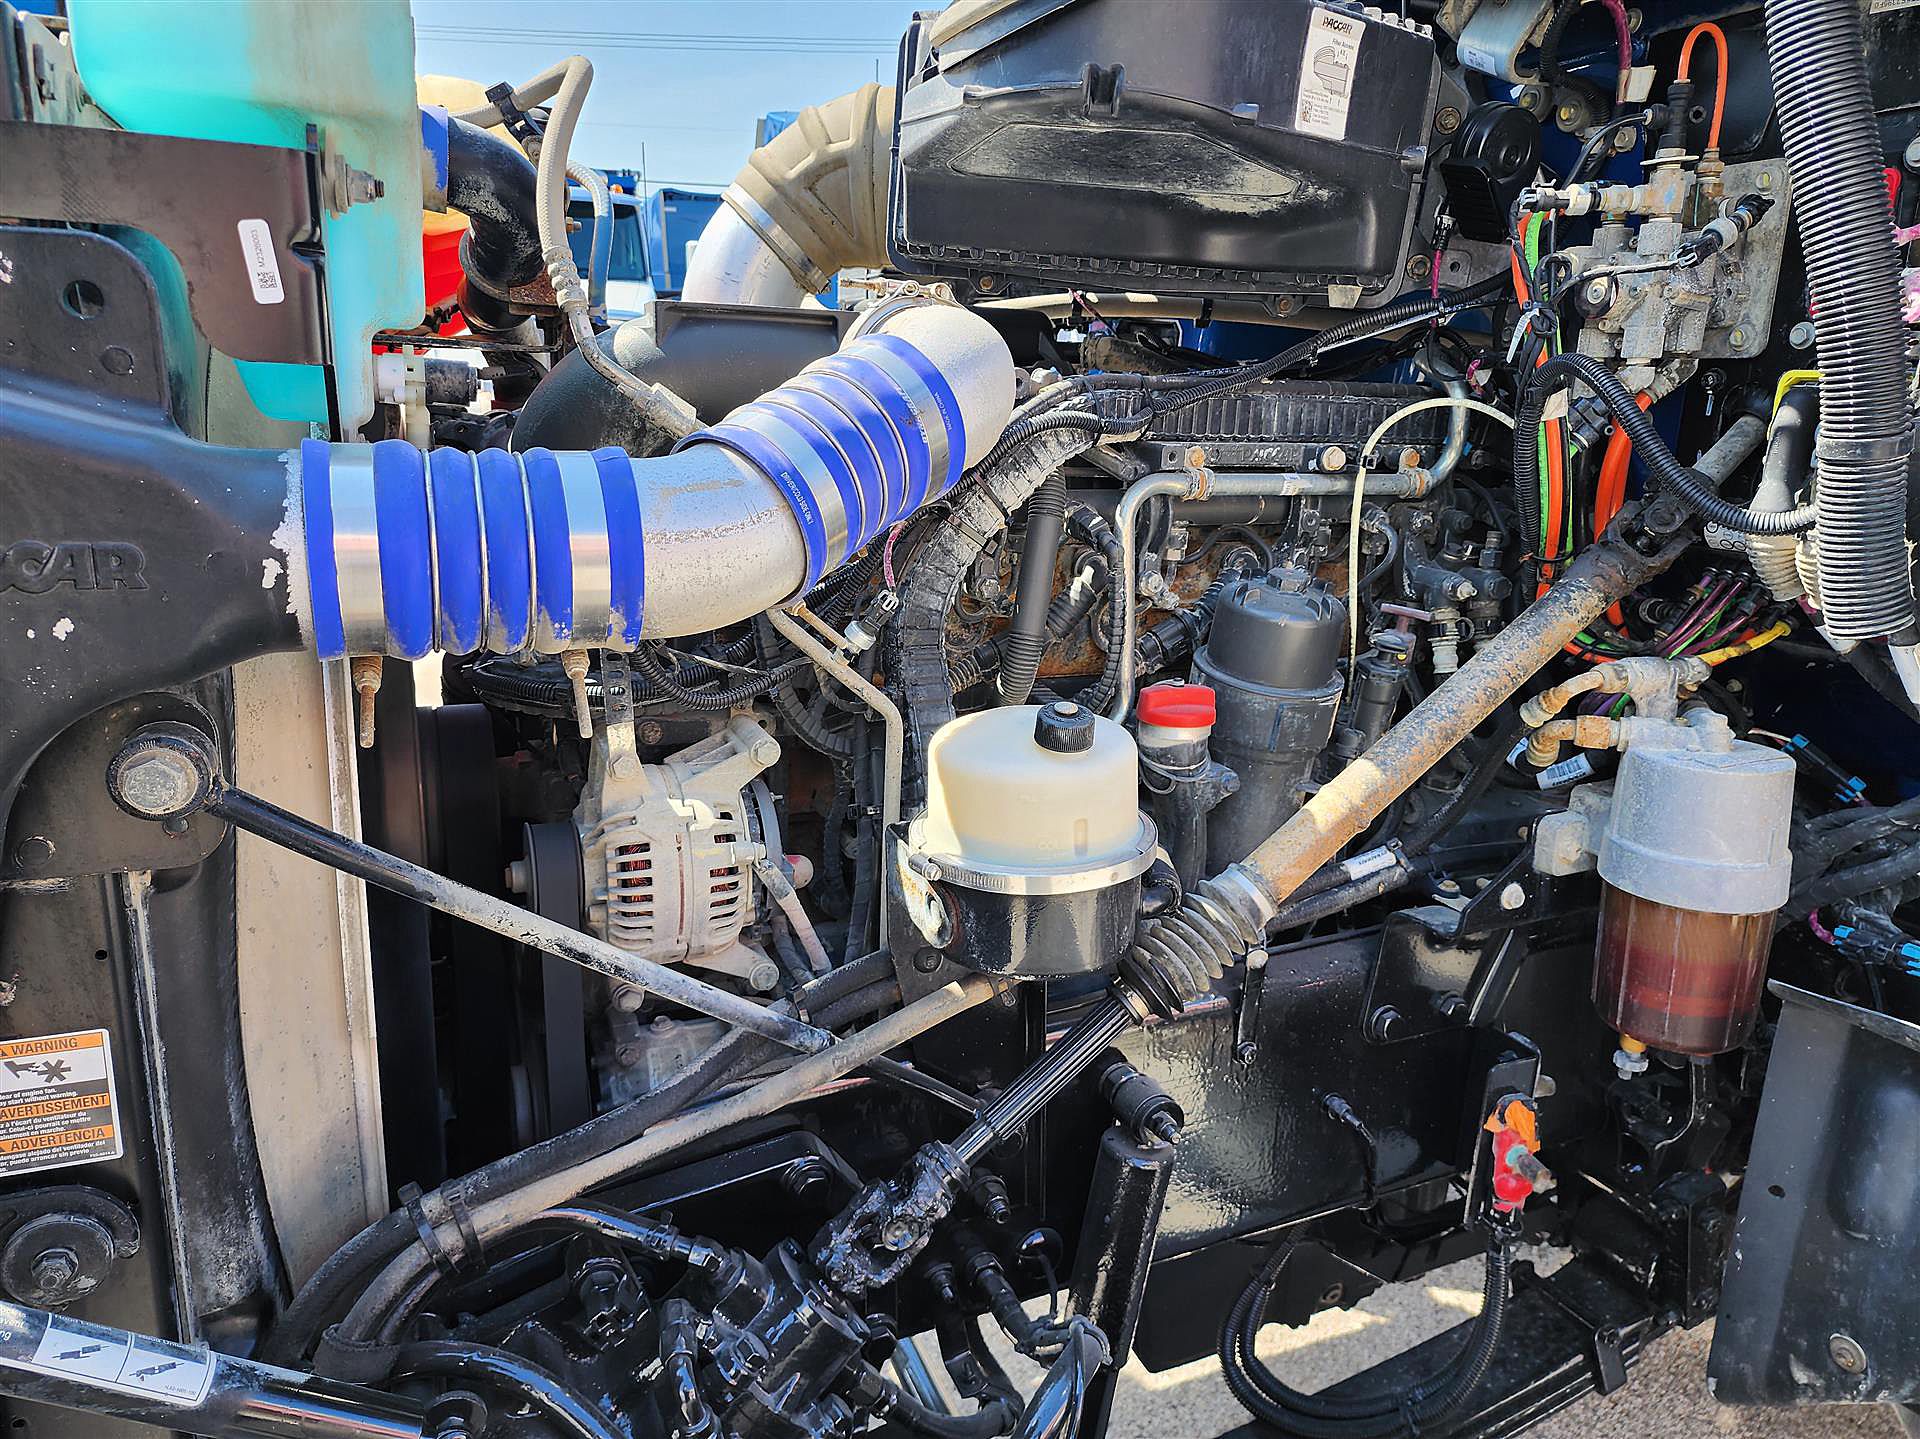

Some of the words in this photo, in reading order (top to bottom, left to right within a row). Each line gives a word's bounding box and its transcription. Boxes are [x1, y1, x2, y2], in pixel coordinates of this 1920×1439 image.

[1322, 16, 1353, 34] PACCAR
[11, 1038, 78, 1055] WARNING
[8, 1097, 24, 1106] start
[24, 1093, 49, 1104] without
[50, 1091, 78, 1100] warning.
[21, 1089, 43, 1100] engine
[0, 1095, 107, 1119] AVERTISSEMENT
[9, 1124, 33, 1134] Celui-ci
[34, 1119, 60, 1132] pourrait
[40, 1125, 66, 1136] marche.
[10, 1127, 105, 1151] ADVERTENCIA
[10, 1157, 29, 1167] puede
[30, 1152, 58, 1162] arrancar
[69, 1147, 90, 1158] previo
[27, 1148, 51, 1158] alejado
